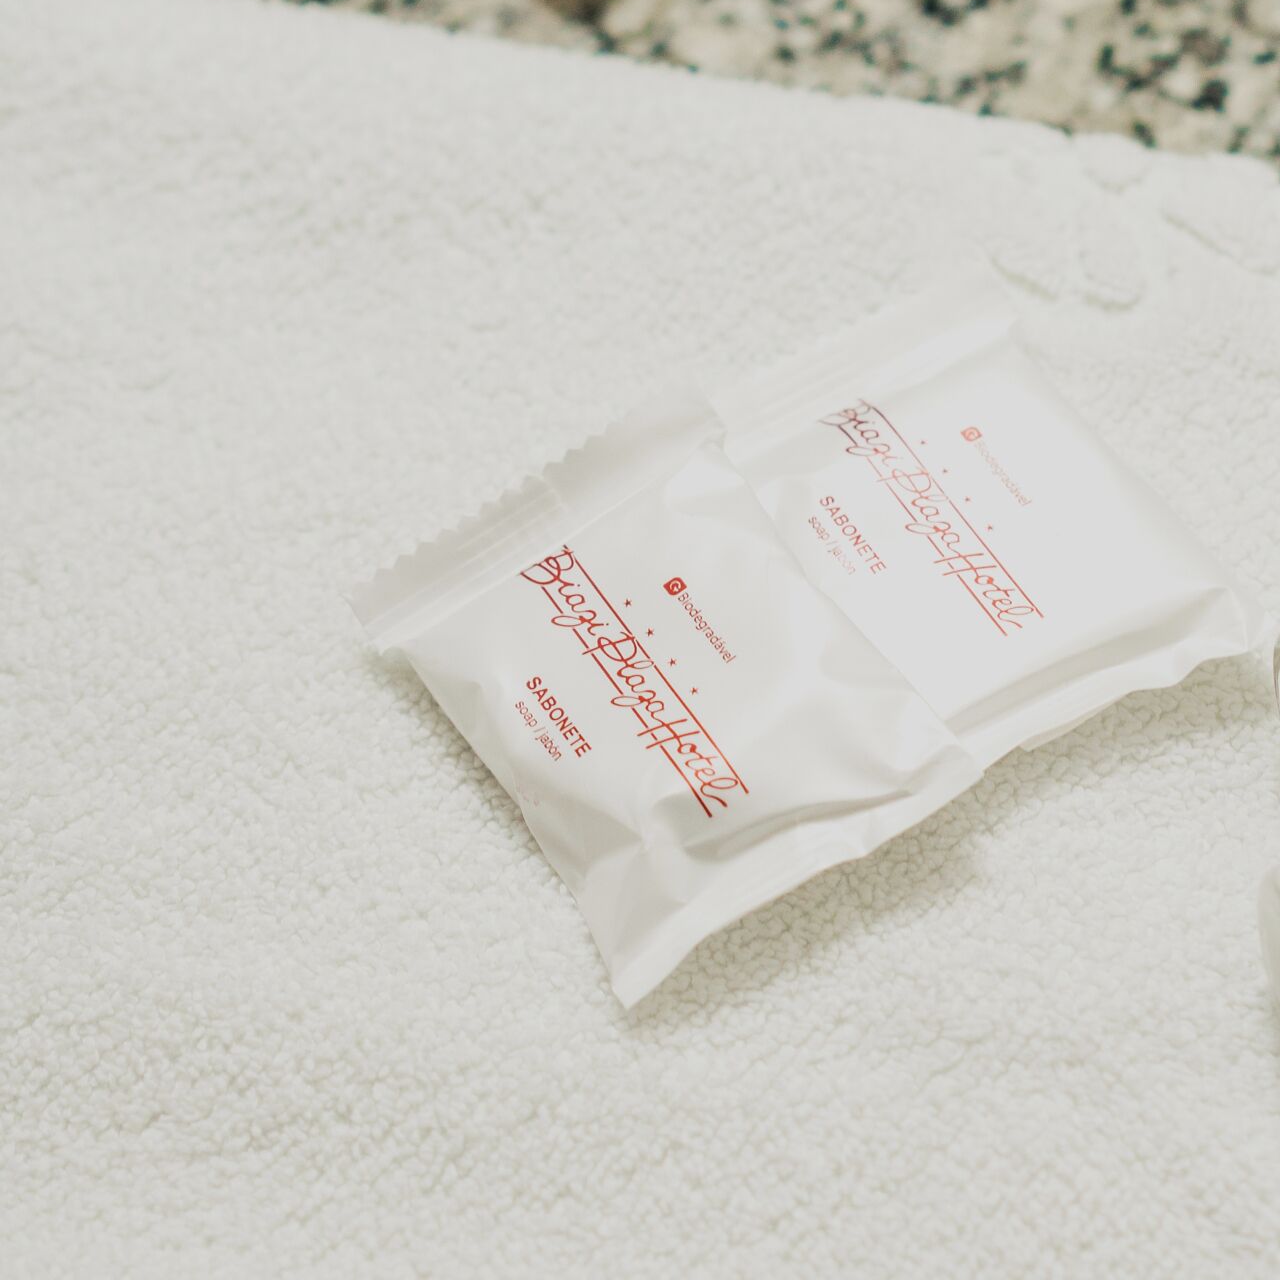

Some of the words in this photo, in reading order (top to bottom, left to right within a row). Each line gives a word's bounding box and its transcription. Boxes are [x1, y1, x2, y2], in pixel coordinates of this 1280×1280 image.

[820, 495, 887, 574] SABONETE
[877, 466, 960, 551] Plaza
[934, 552, 1034, 629] Hotel
[678, 591, 737, 663] Biodegradável
[519, 544, 609, 636] Biazi
[582, 631, 664, 720] Plaza
[637, 718, 738, 808] Hotel
[515, 701, 538, 727] soap
[534, 730, 562, 761] jabón
[526, 676, 592, 758] SABONETE
